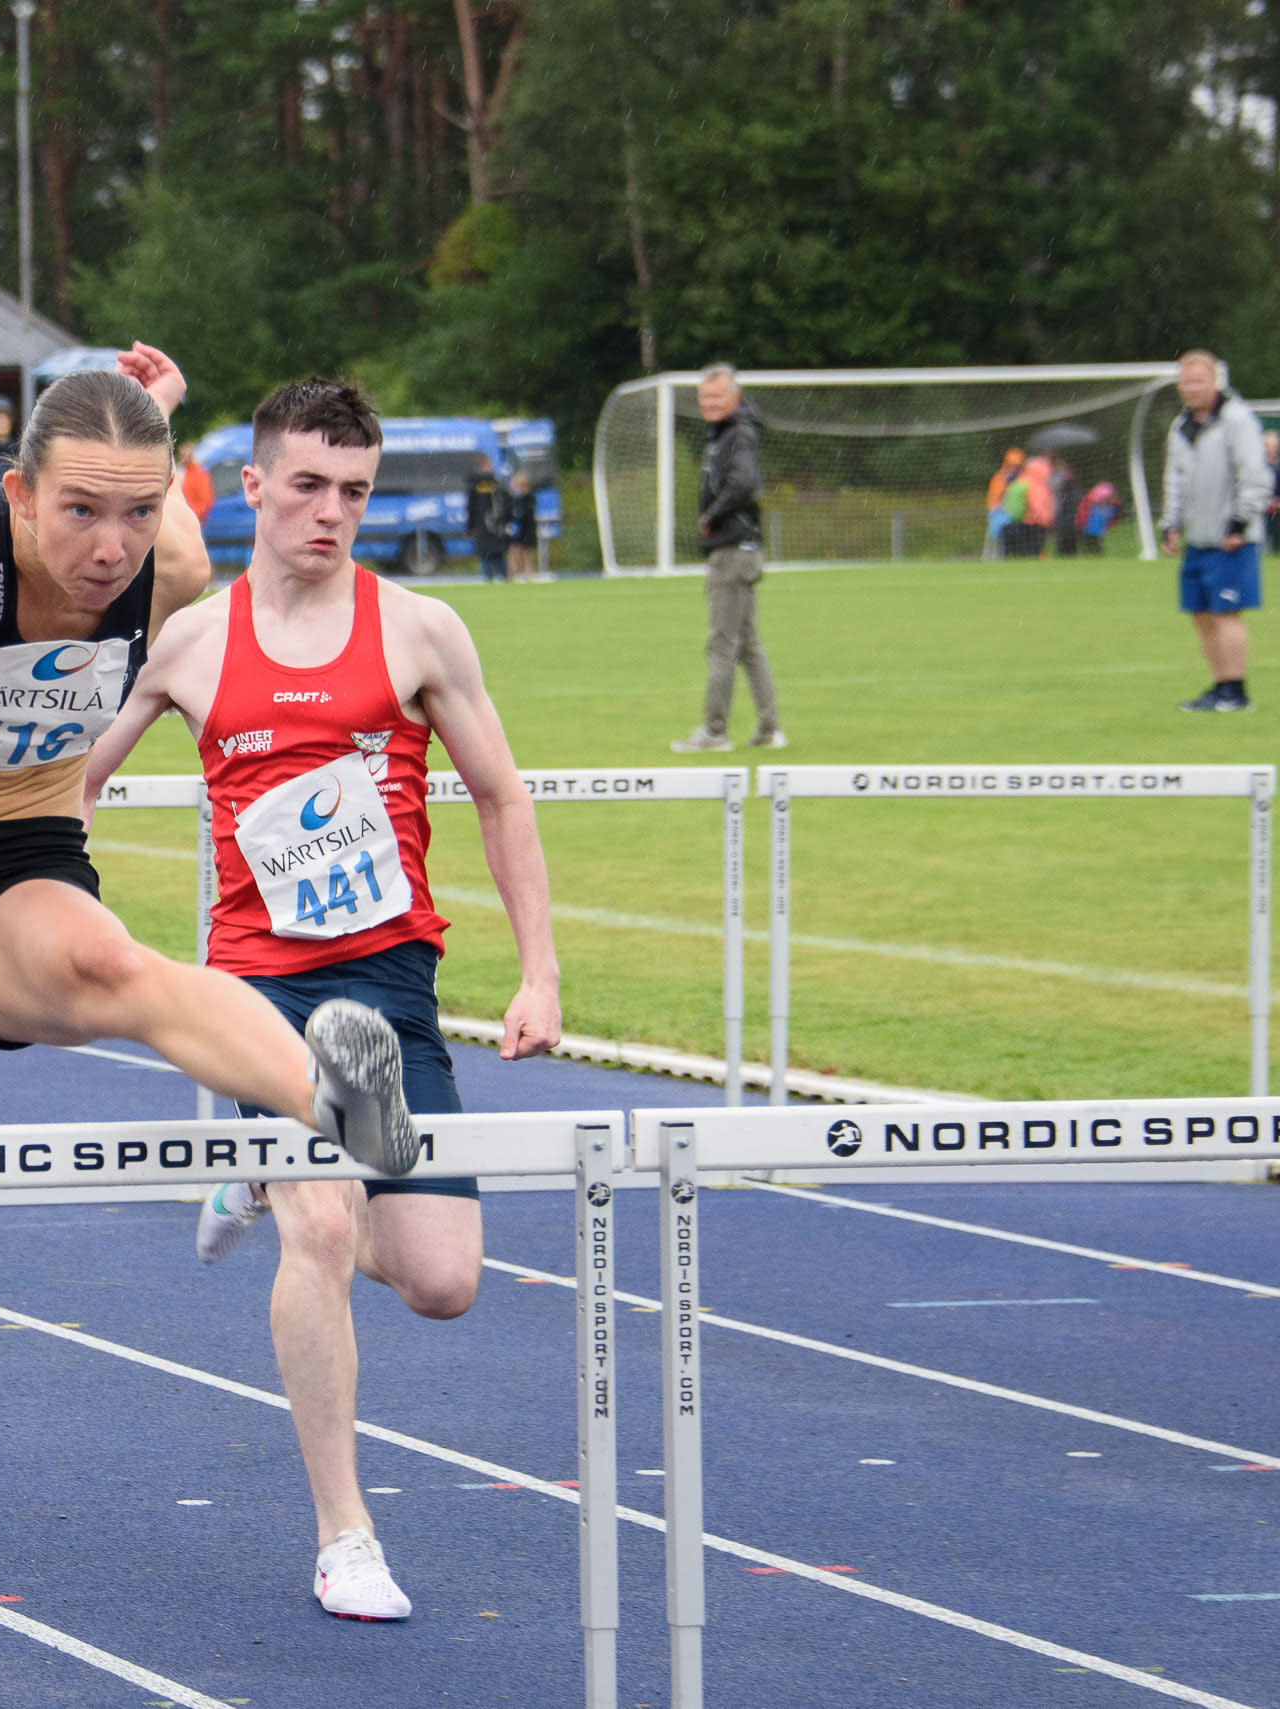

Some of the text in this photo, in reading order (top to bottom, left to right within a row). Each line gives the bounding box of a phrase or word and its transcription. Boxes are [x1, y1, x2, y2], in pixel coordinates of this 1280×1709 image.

[273, 691, 320, 703] CRAFT
[236, 730, 274, 743] INTER
[237, 740, 273, 754] SPORT
[523, 777, 655, 794] ORT.COM
[261, 813, 377, 878] WÄRTSILÄ
[296, 849, 383, 927] 441
[1143, 1115, 1280, 1146] SPO
[73, 1134, 434, 1171] SPORT.C
